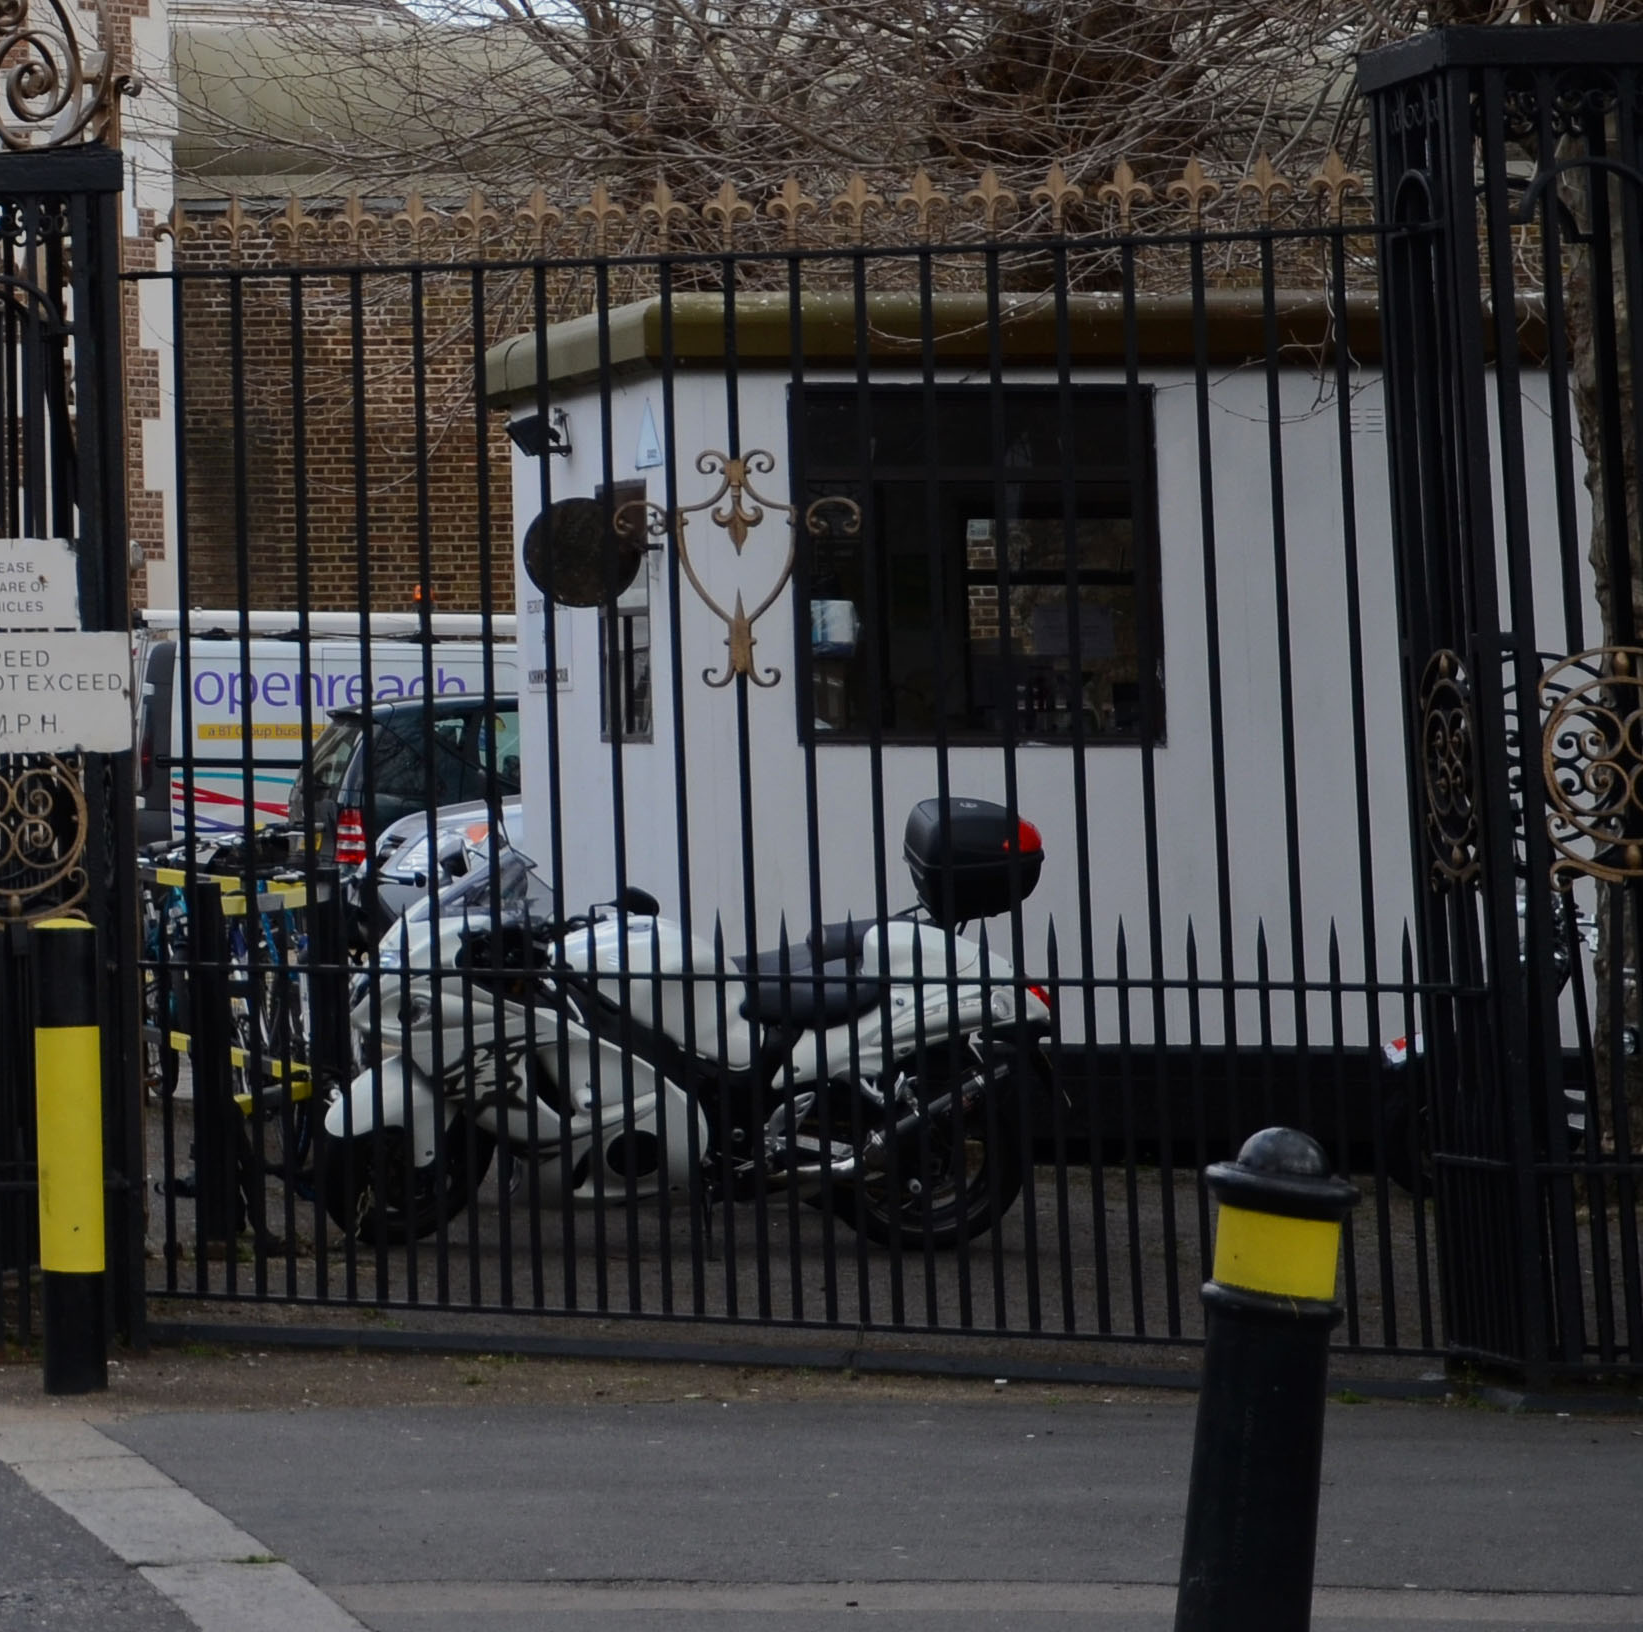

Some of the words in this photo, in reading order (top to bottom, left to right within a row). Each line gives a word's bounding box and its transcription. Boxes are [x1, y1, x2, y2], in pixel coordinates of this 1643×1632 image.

[30, 580, 50, 593] OF
[27, 673, 122, 692] EXCEED
[235, 727, 272, 739] Goup
